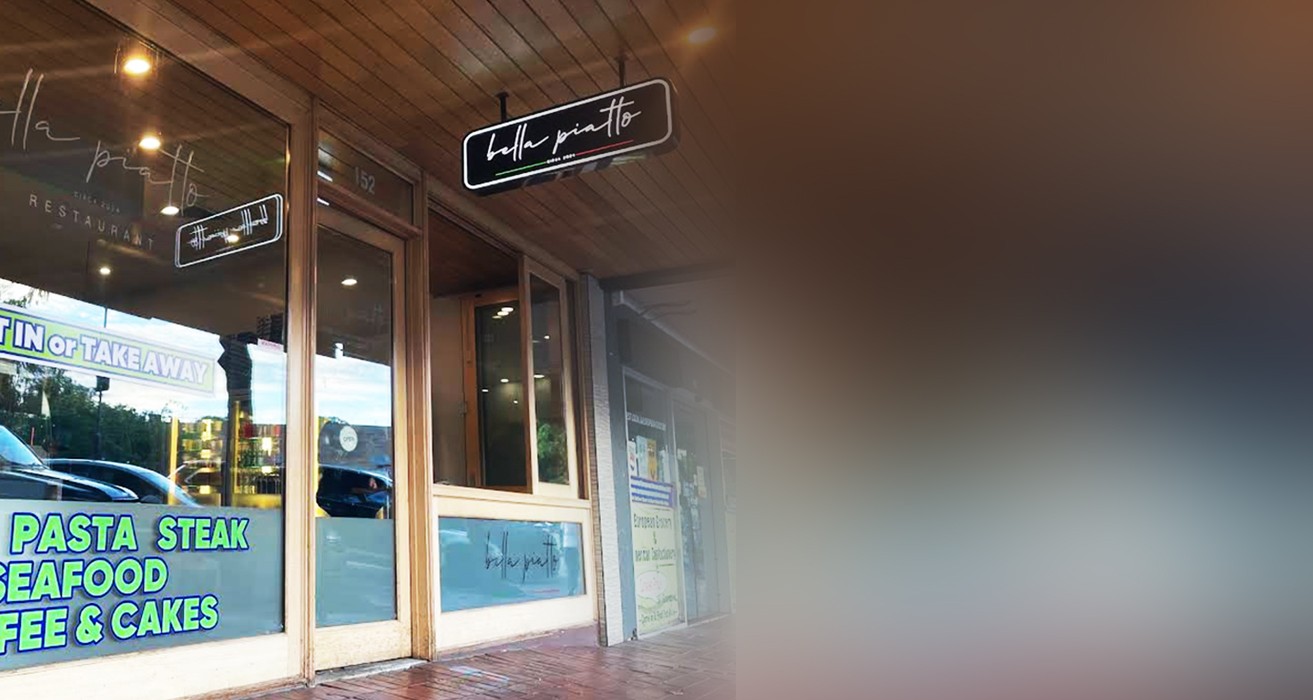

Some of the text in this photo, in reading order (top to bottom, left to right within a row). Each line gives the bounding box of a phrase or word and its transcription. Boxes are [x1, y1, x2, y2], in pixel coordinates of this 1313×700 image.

[487, 96, 642, 162] bella piatto
[86, 143, 209, 217] piatto
[355, 166, 375, 195] 152
[29, 193, 154, 250] RESTAURANT
[13, 318, 45, 353] IN
[48, 334, 78, 356] or
[80, 334, 141, 370] TAKE
[140, 352, 208, 384] AWAY
[10, 512, 138, 555] PASTA
[156, 515, 250, 551] STEAK
[485, 531, 520, 578] bella
[75, 603, 104, 645] &
[110, 595, 220, 640] CAKES
